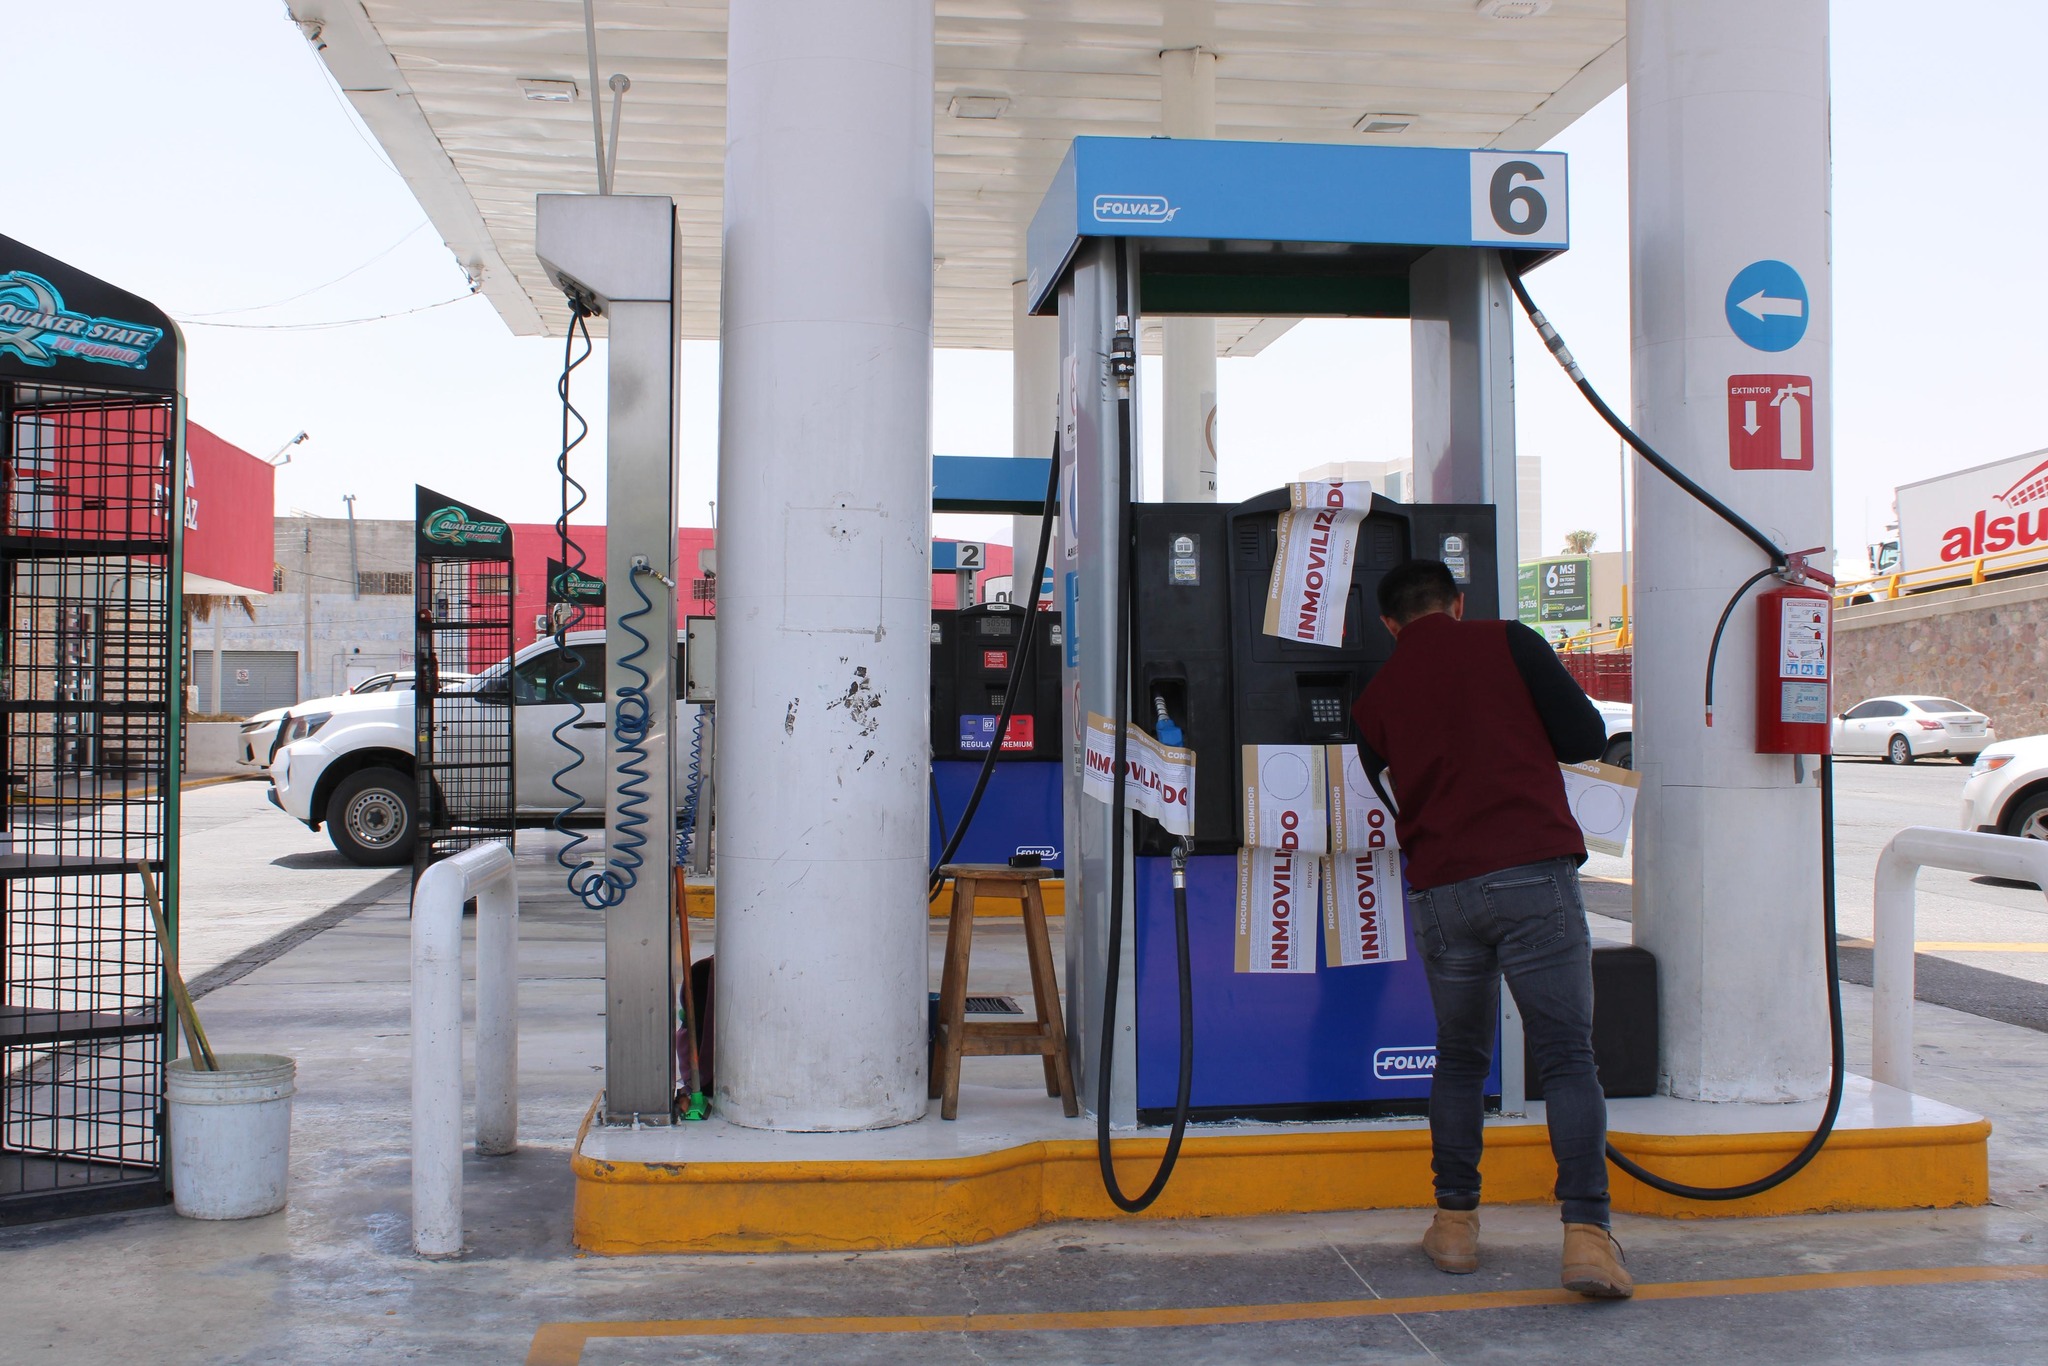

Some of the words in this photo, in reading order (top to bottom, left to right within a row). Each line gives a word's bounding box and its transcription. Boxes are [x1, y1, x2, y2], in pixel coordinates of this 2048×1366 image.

[1102, 202, 1160, 215] FOLVAZ
[1489, 160, 1547, 236] 6
[0, 304, 86, 336] QUAKER
[87, 324, 154, 347] STATE
[1731, 386, 1771, 394] EXTINTOR
[440, 520, 477, 532] QUAKER
[477, 524, 504, 534] STATE
[961, 545, 979, 566] 2
[1297, 482, 1344, 640] INMOVILIZAD
[1546, 565, 1559, 588] 6
[1560, 564, 1576, 574] MSI
[961, 740, 993, 748] REGULA
[1086, 749, 1188, 806] INMVILIZDO
[1248, 786, 1256, 845] CONSUMIDOR
[1335, 786, 1343, 844] CONSUMIDOR
[1239, 862, 1249, 935] PROCURADURÍA
[1271, 810, 1299, 970] INMOVILIDO
[1362, 808, 1386, 960] INMOVILDO
[1383, 1055, 1437, 1070] FOLVA
